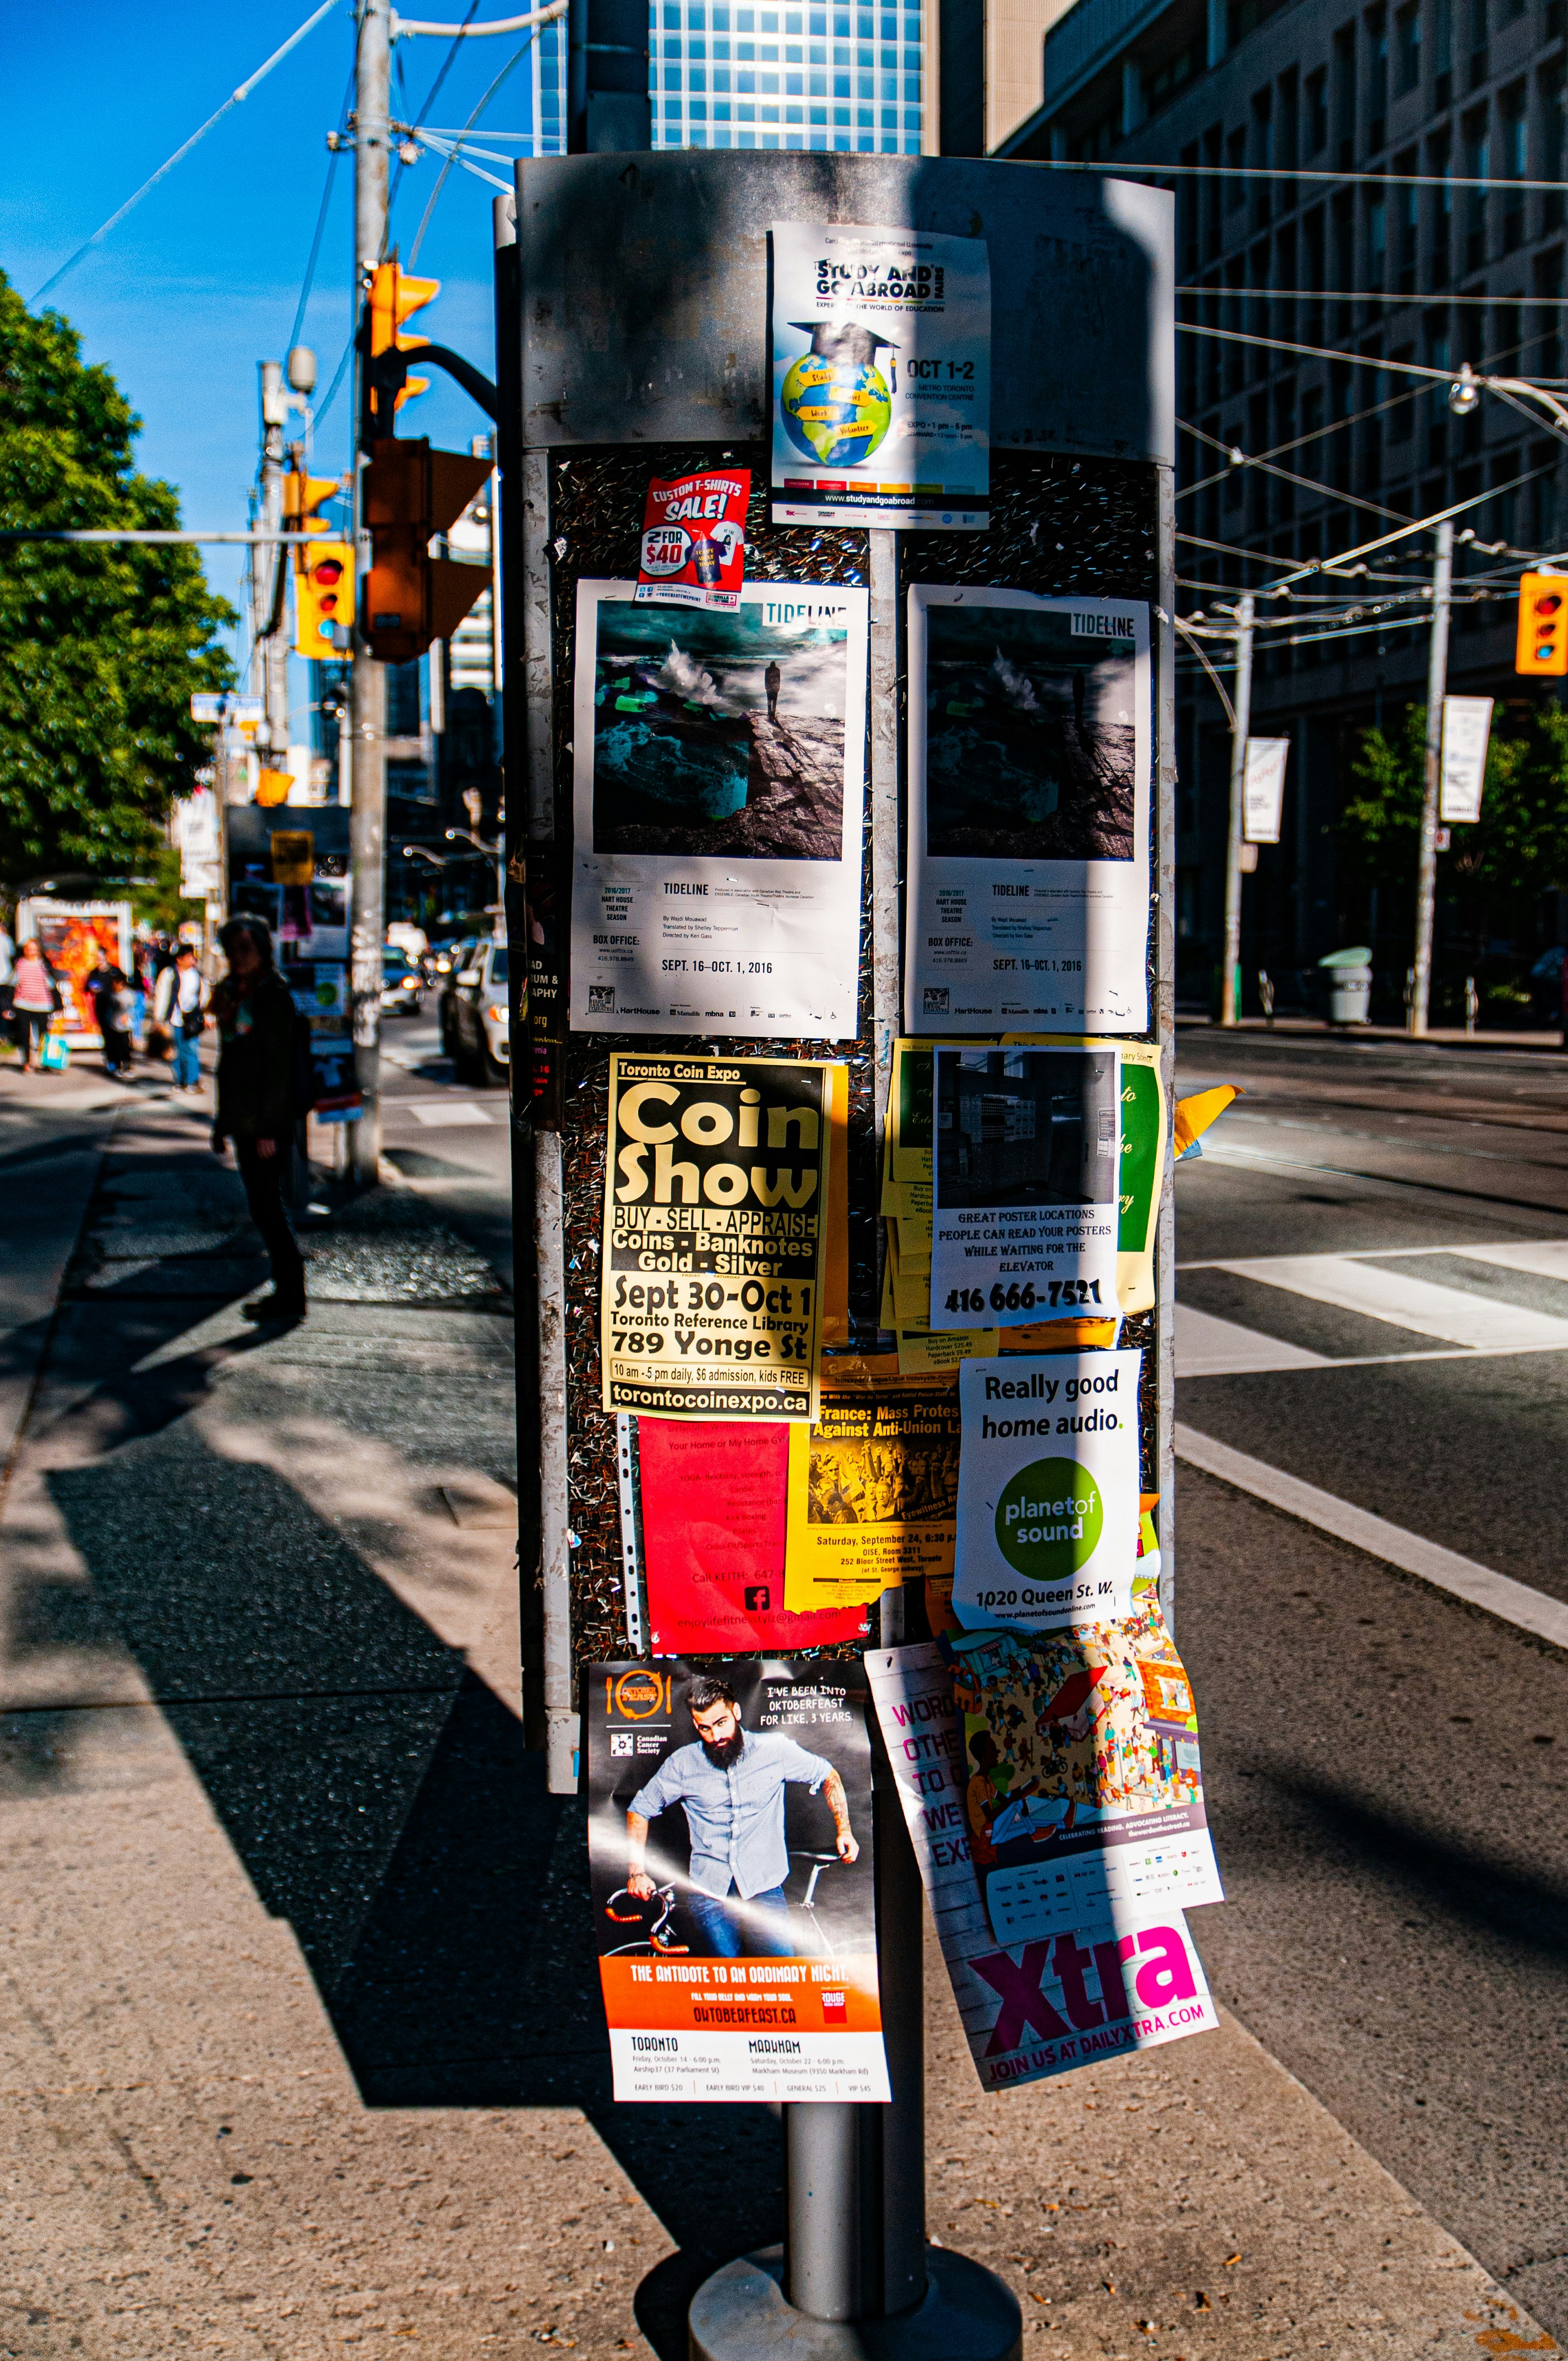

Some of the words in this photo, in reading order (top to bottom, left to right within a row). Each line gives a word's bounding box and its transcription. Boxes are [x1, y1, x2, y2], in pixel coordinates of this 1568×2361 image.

[887, 265, 932, 282] AND
[934, 266, 944, 299] FAIRS
[851, 281, 931, 299] ABROAD
[812, 373, 831, 382] Study
[907, 359, 942, 379] OCT
[946, 361, 974, 380] 1-2
[905, 393, 947, 401] CONVENTION
[839, 425, 869, 435] Volunteer
[652, 481, 693, 503] CUSTOM
[695, 479, 743, 497] T-SHIRTS
[825, 494, 934, 506] www.studyandgoabroad.com
[663, 493, 728, 521] SALE!
[647, 530, 661, 544] 2
[662, 530, 683, 544] FOR
[646, 544, 683, 565] $40
[656, 592, 701, 602] #YOUCREATEWEPRINT
[1074, 613, 1135, 638] TIDELINE
[663, 882, 709, 896] TIDELINE
[992, 884, 1030, 897] TIDELINE
[593, 934, 608, 945] BOX
[609, 935, 640, 945] OFFICE:
[662, 959, 689, 972] SEPT.
[737, 961, 745, 975] 1,
[748, 962, 772, 973] 2016
[993, 959, 1018, 971] SEPT.
[1052, 960, 1060, 973] 1,
[1061, 960, 1082, 972] 2016
[620, 1007, 660, 1015] HartHouse
[619, 1062, 671, 1077] Toronto
[673, 1062, 703, 1079] Coin
[707, 1065, 741, 1082] Expo
[617, 1081, 820, 1149] Coin
[615, 1141, 818, 1209] Show
[614, 1206, 651, 1230] BUY
[666, 1207, 711, 1231] SELL
[726, 1211, 815, 1238] APPRAISE
[957, 1212, 997, 1225] GREAT
[998, 1211, 1037, 1222] POSTER
[1039, 1209, 1095, 1221] LOCATIONS
[938, 1230, 981, 1241] PEOPLE
[983, 1228, 1005, 1240] CAN
[1008, 1227, 1037, 1239] READ
[1038, 1226, 1064, 1237] YOUR
[1065, 1225, 1112, 1237] POSTERS
[612, 1229, 675, 1251] Coins
[695, 1232, 813, 1257] Banknotes
[964, 1247, 998, 1258] WHILE
[1000, 1244, 1044, 1256] WAITING
[1046, 1243, 1064, 1254] FOR
[1066, 1242, 1086, 1253] THE
[638, 1251, 693, 1272] Gold
[715, 1253, 783, 1277] Silver
[999, 1260, 1054, 1273] ELEVATOR
[614, 1275, 679, 1315] Sept
[688, 1279, 793, 1314] 30-Oct
[800, 1286, 812, 1316] 1
[945, 1287, 985, 1312] 416
[989, 1278, 1104, 1312] 666-7521
[610, 1310, 669, 1328] Toronto
[673, 1312, 748, 1330] Reference
[752, 1315, 809, 1336] Library
[611, 1331, 665, 1354] 789
[674, 1330, 771, 1361] Yonge
[779, 1333, 808, 1360] St
[671, 1367, 694, 1385] daily,
[696, 1368, 706, 1382] $6
[709, 1367, 756, 1384] admission,
[759, 1369, 777, 1384] kids
[780, 1371, 804, 1385] FREE
[985, 1374, 1060, 1404] Really
[1065, 1369, 1119, 1402] good
[613, 1384, 808, 1413] torontocoinexpo.ca
[819, 1405, 872, 1421] France:
[876, 1405, 908, 1419] Mass
[813, 1421, 869, 1438] Against
[873, 1419, 941, 1437] Anti-Union
[982, 1415, 1050, 1439] home
[1055, 1408, 1123, 1435] audio.
[668, 1441, 688, 1451] Your
[690, 1440, 715, 1450] Home
[1017, 1517, 1084, 1543] sound
[816, 1536, 858, 1547] Saturday,
[861, 1534, 904, 1545] September
[862, 1548, 881, 1557] OISE,
[977, 1589, 1017, 1608] 1020
[1021, 1587, 1073, 1606] Queen
[1076, 1583, 1094, 1598] St.
[1098, 1581, 1113, 1595] W.
[767, 1686, 789, 1698] I'VE
[791, 1685, 817, 1697] BEEN
[819, 1685, 846, 1696] INTO
[769, 1698, 844, 1711] OKTOBERFEAST
[760, 1713, 779, 1726] FOR
[781, 1713, 808, 1726] LIKE,
[810, 1712, 818, 1723] 3
[819, 1711, 853, 1723] YEARS.
[922, 1802, 962, 1831] WE
[1126, 1816, 1162, 1829] ADVOCATING
[1163, 1812, 1189, 1823] LITERACY.
[630, 1965, 652, 1982] THE
[656, 1965, 709, 1983] ANTIDOTE
[712, 1966, 728, 1983] TO
[731, 1966, 746, 1983] AN
[749, 1966, 807, 1983] ORDINARY
[811, 1964, 849, 1982] NIGHT.
[967, 1925, 1197, 2057] Xtra
[693, 2006, 797, 2024] OKTOBERFEAST.CA
[630, 2036, 679, 2052] TORONTO
[748, 2039, 802, 2054] MARKHAM
[990, 2057, 1030, 2081] JOIN
[1031, 2047, 1057, 2069] US
[1060, 2041, 1079, 2061] AT
[1080, 2004, 1205, 2055] DAILYXTRA.COM
